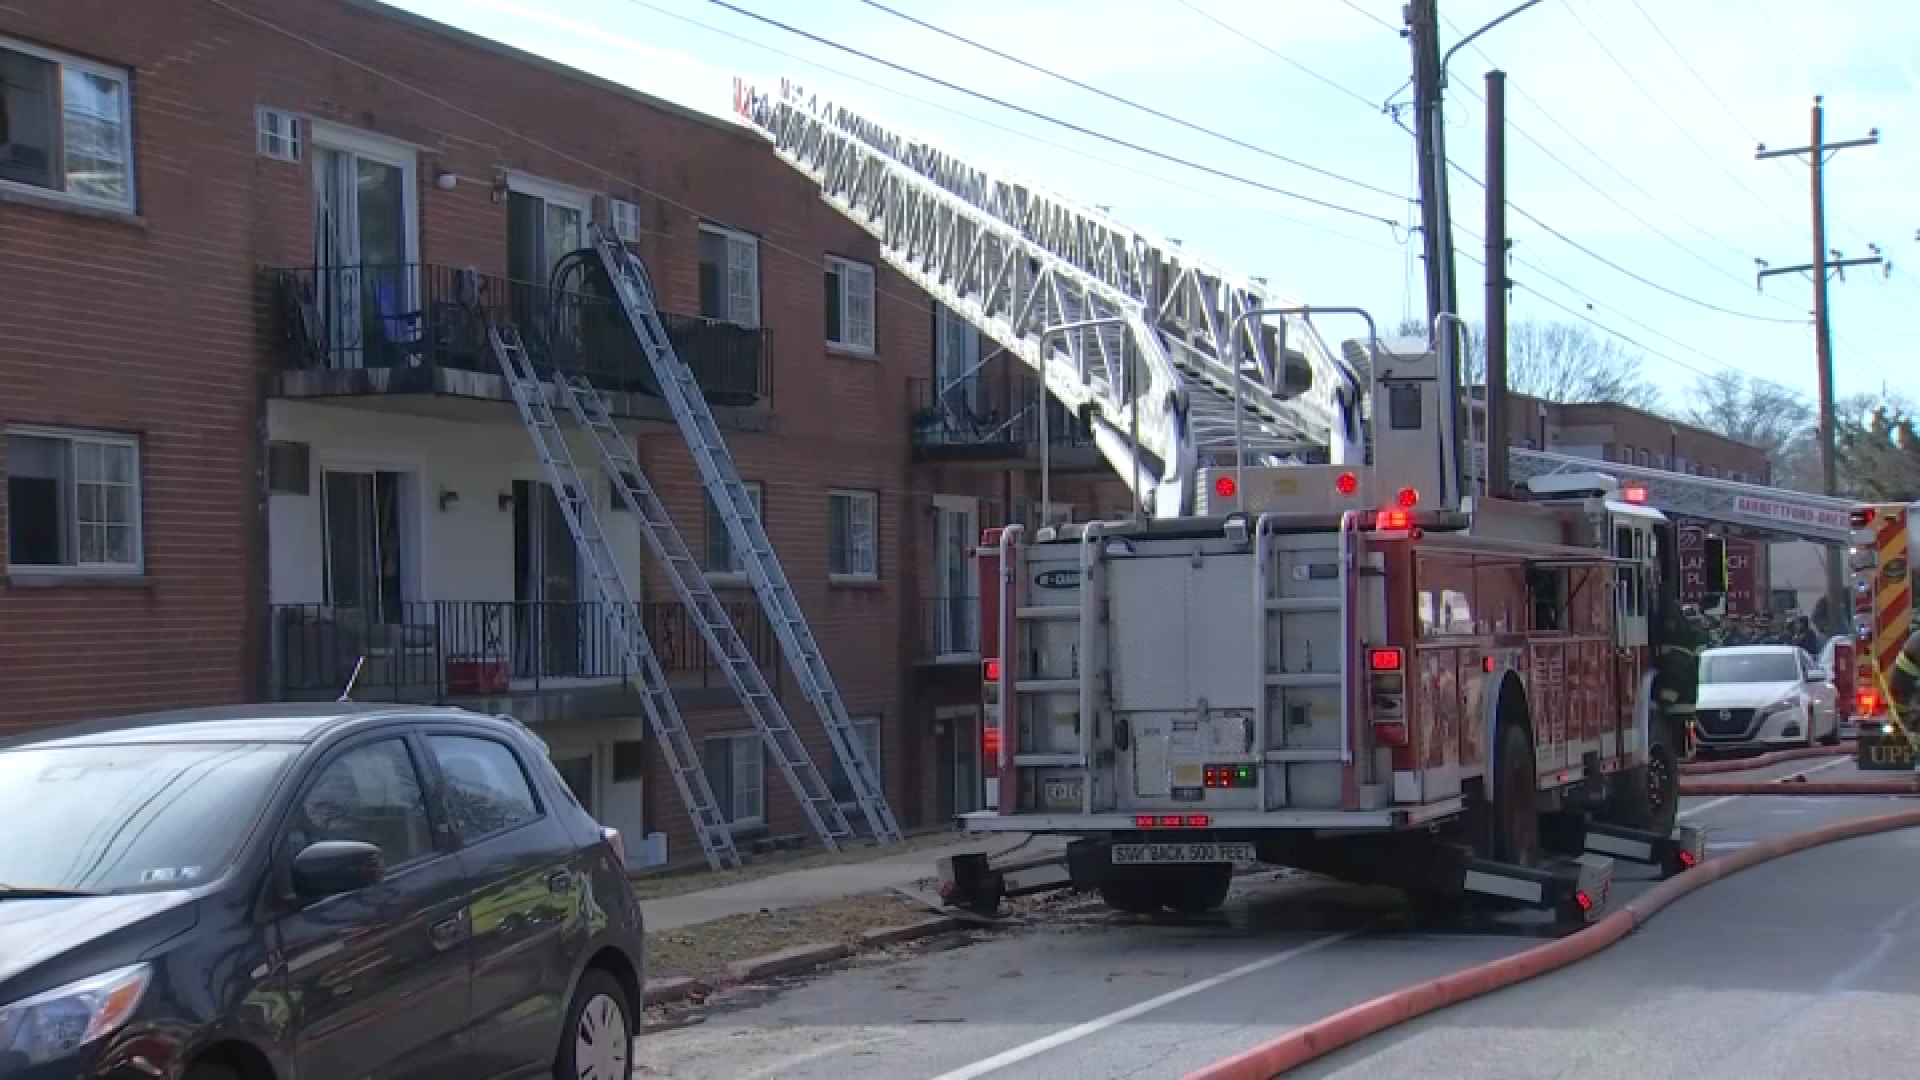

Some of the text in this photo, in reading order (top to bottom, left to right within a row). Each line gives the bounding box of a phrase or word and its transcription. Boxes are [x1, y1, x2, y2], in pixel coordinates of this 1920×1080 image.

[1116, 845, 1250, 861] STAY BACK 500 FEET
